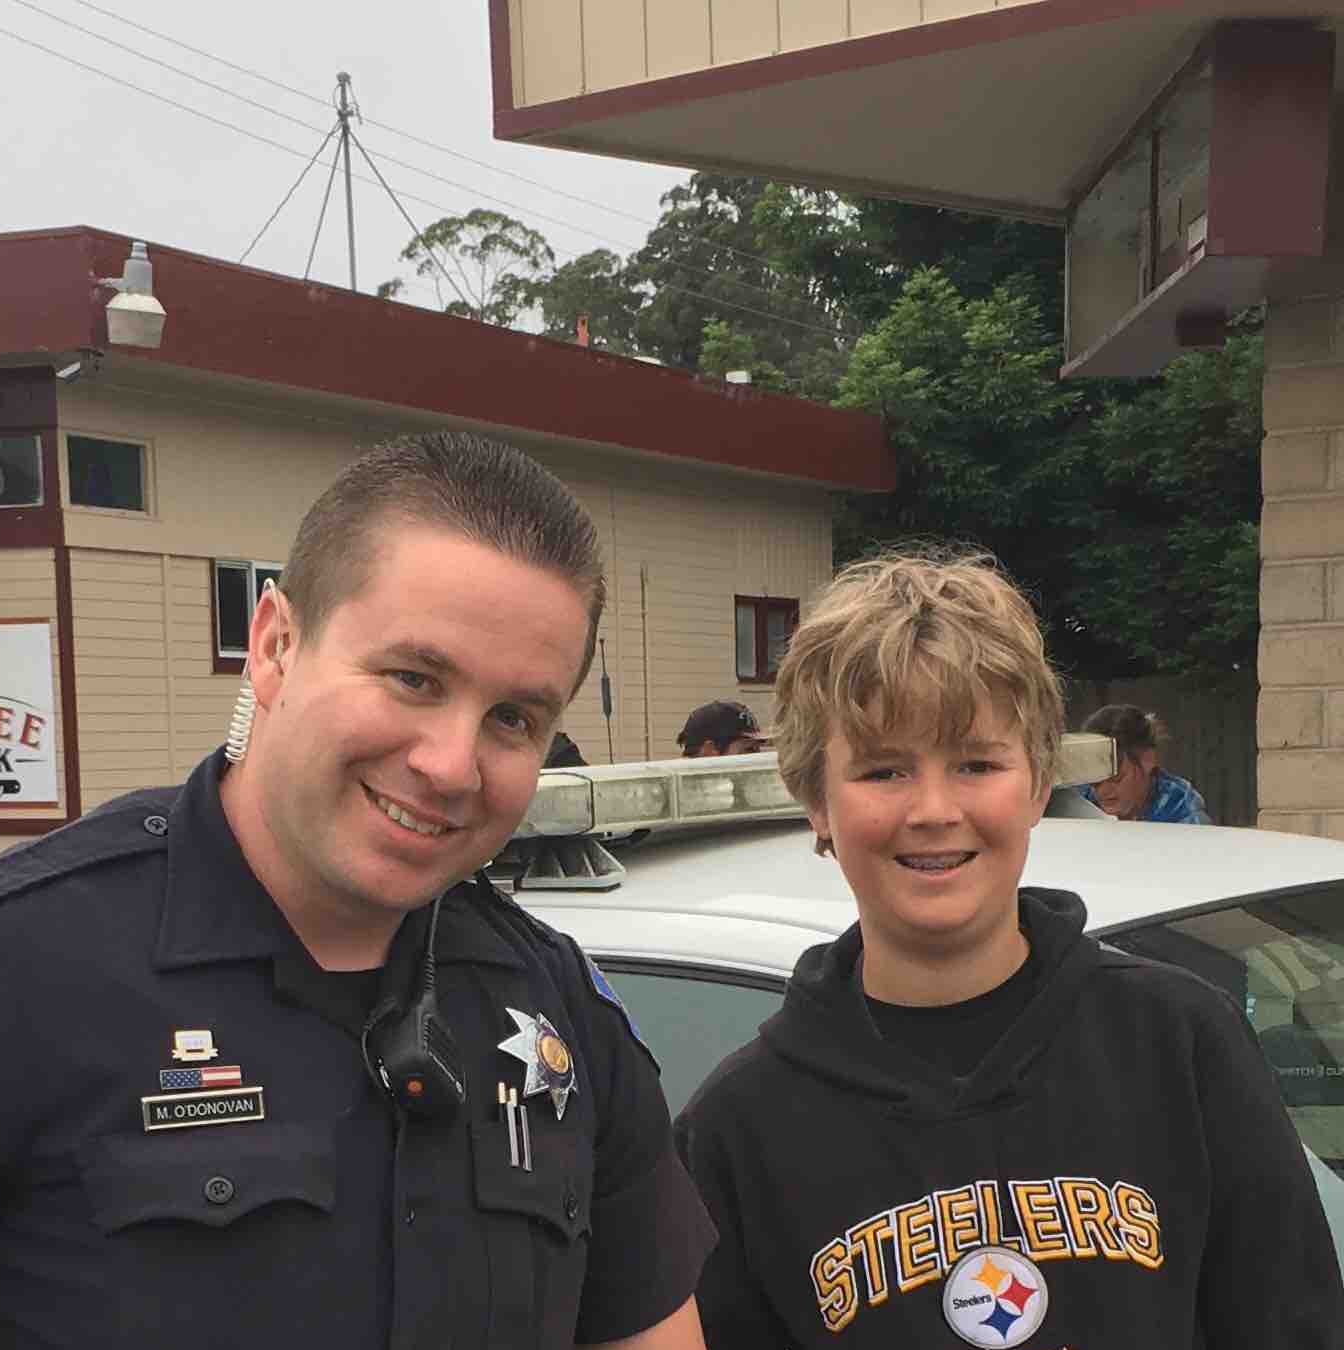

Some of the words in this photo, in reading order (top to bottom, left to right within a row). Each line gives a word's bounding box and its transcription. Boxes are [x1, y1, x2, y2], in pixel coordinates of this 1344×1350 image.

[156, 1106, 173, 1121] M.
[174, 1099, 255, 1119] O'DONOVAN
[808, 1176, 1165, 1334] STEELERS
